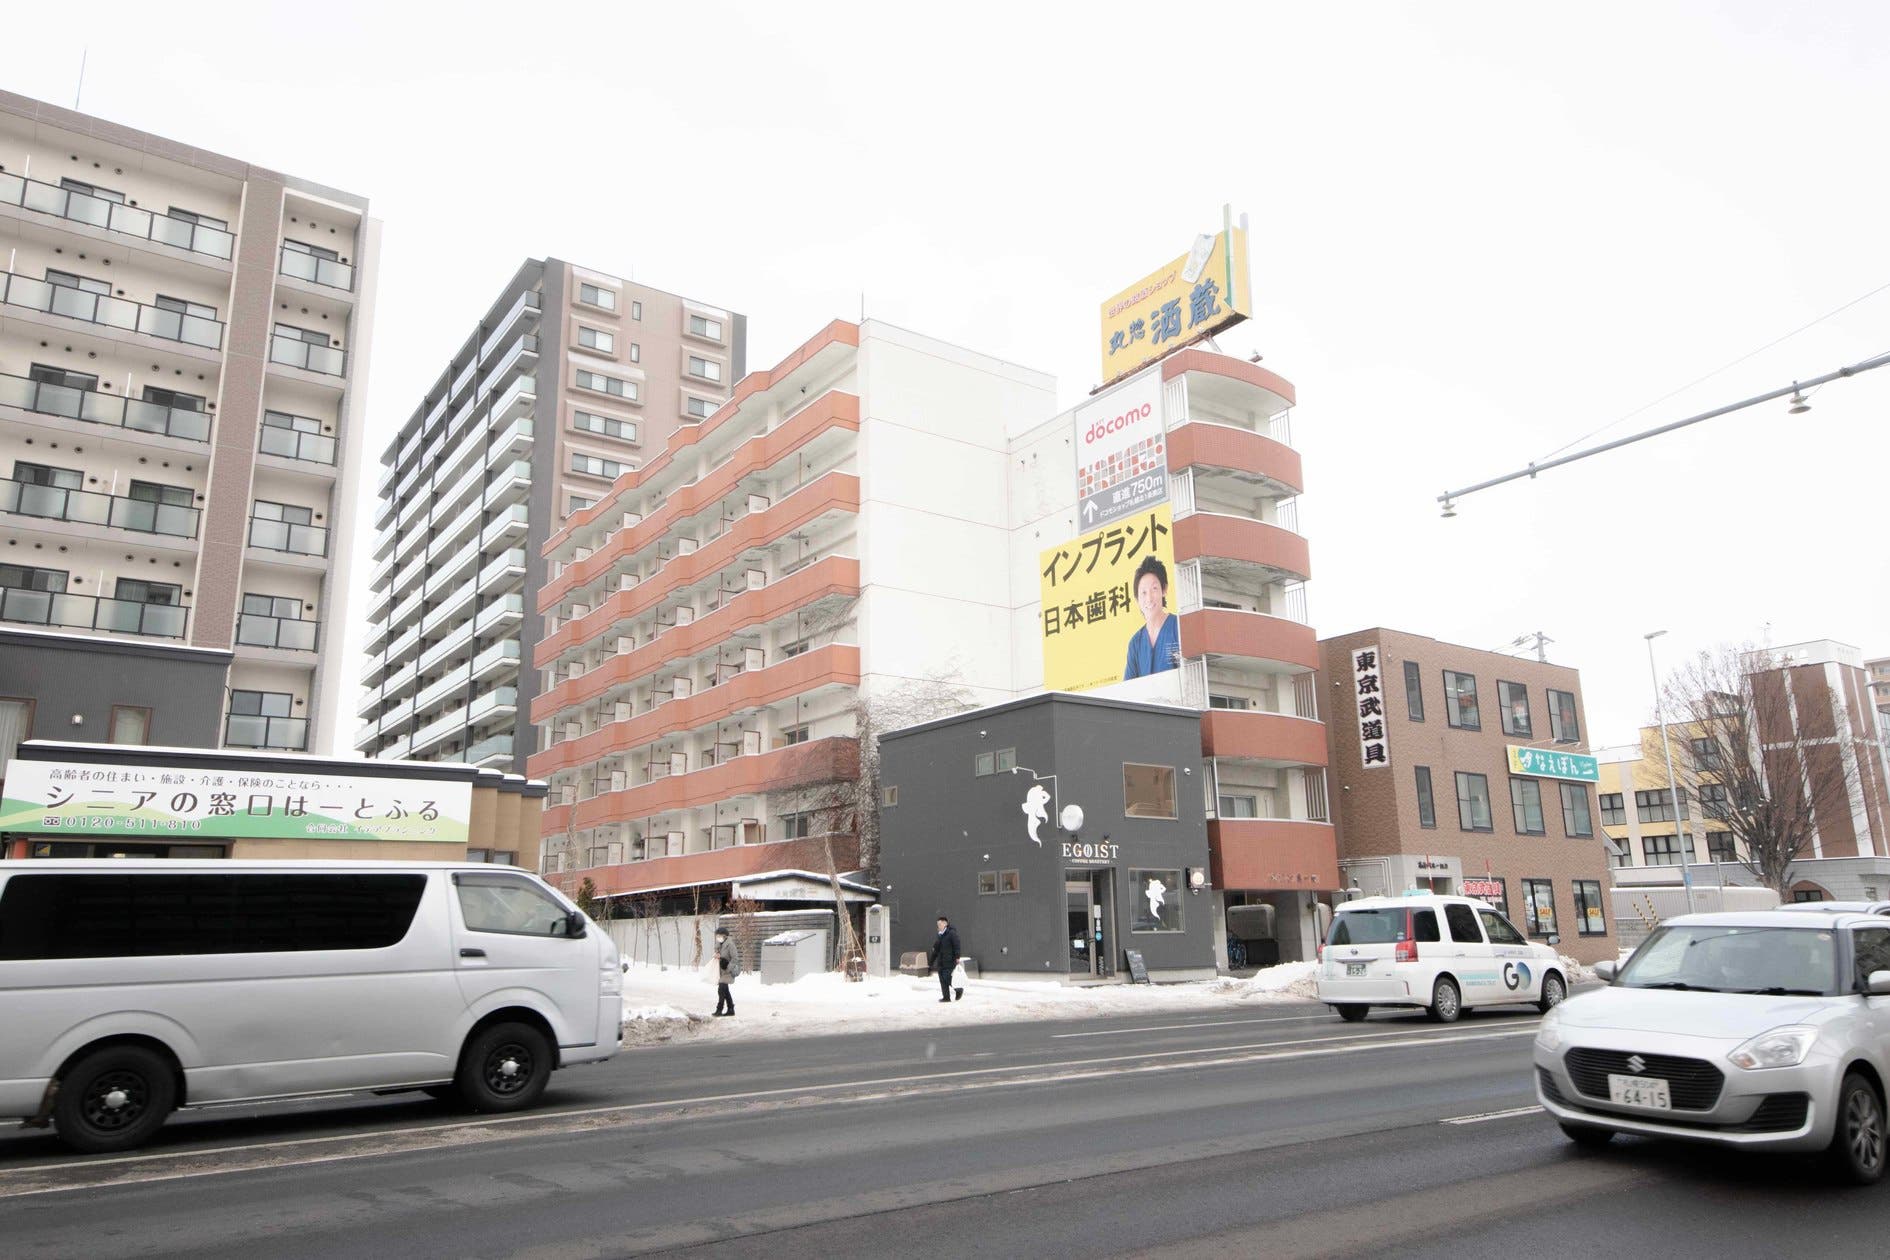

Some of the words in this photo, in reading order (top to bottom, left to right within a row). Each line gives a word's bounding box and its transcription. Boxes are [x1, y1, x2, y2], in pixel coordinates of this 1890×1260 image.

[1085, 403, 1151, 445] docomo
[1043, 513, 1169, 588] インプラント
[1044, 581, 1132, 638] 日本歯科
[1356, 651, 1386, 765] 東京武道具
[1062, 842, 1119, 859] EGOIST
